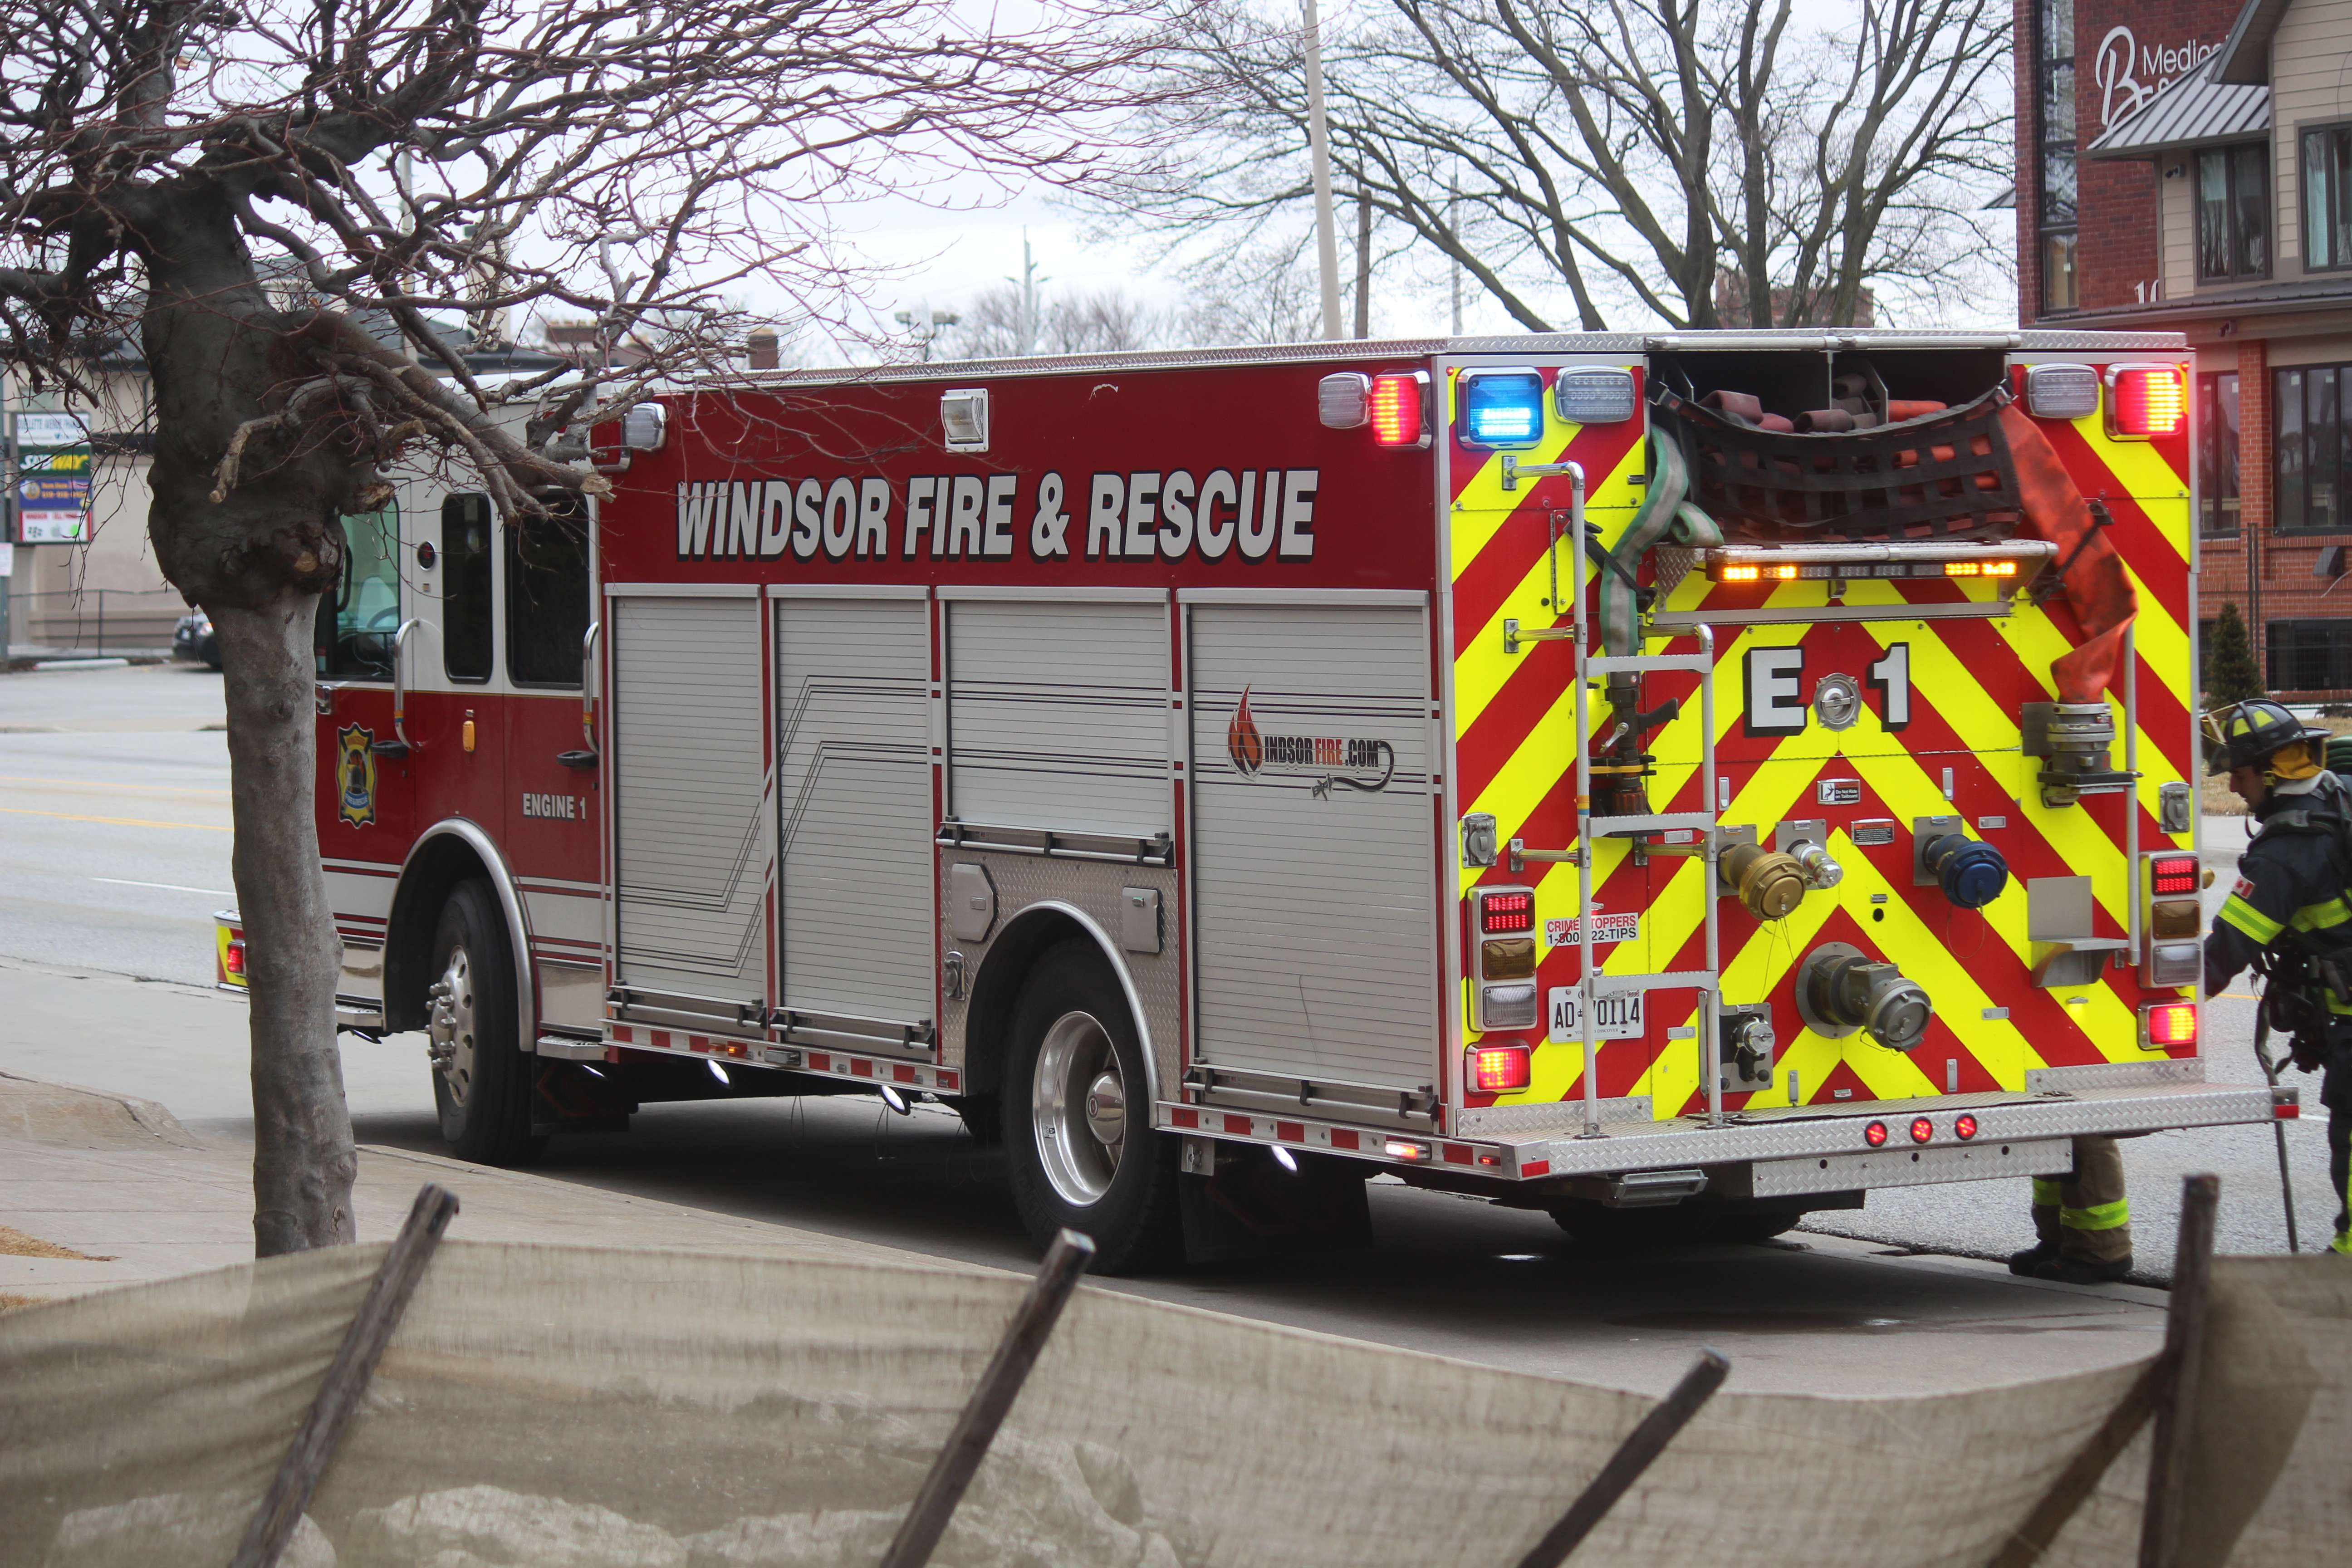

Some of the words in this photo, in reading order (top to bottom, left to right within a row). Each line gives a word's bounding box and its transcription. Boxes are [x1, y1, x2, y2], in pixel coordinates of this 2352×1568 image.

[20, 454, 89, 470] SUBWAY
[678, 476, 888, 556] WINDSOR
[904, 475, 1017, 556] FIRE
[1031, 472, 1070, 557] &
[1088, 470, 1318, 558] RESCUE
[1745, 648, 1806, 732] E
[1869, 644, 1909, 727] 1
[523, 793, 575, 818] ENGINE
[579, 797, 586, 819] 1
[1547, 920, 1579, 932] CRIME
[1591, 915, 1636, 929] TOPPERS
[1555, 1002, 1574, 1028] AD
